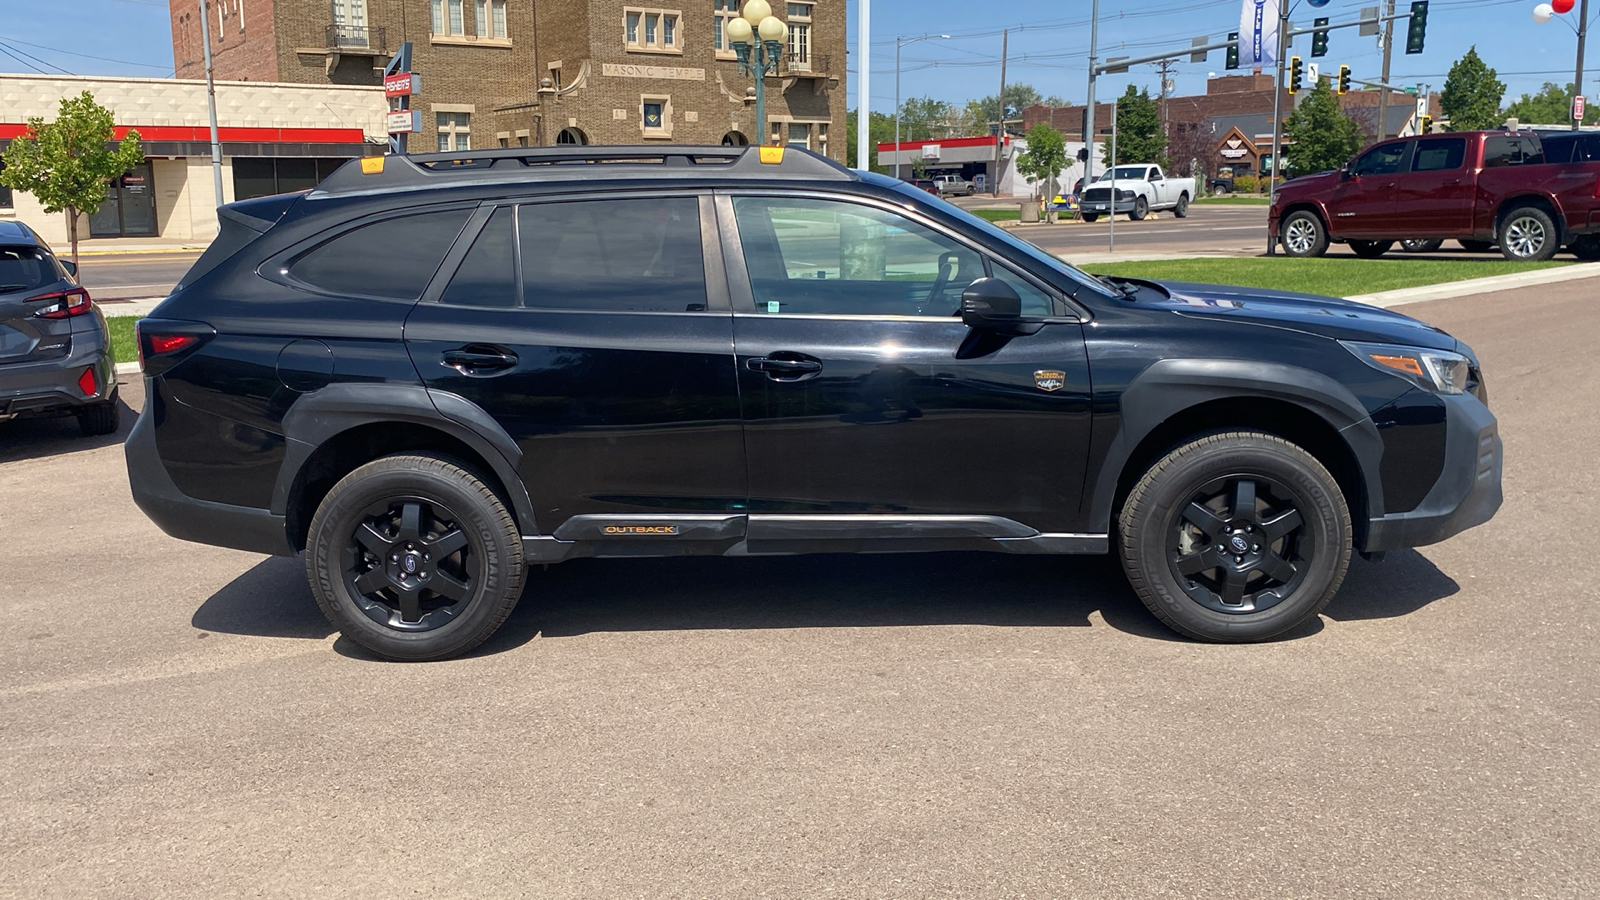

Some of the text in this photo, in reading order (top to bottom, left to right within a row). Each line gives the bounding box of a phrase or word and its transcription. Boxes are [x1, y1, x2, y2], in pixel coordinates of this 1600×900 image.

[604, 64, 704, 79] MASONIC TEMPLE
[317, 534, 342, 612] COUNTRY
[472, 516, 499, 587] IRONMAN
